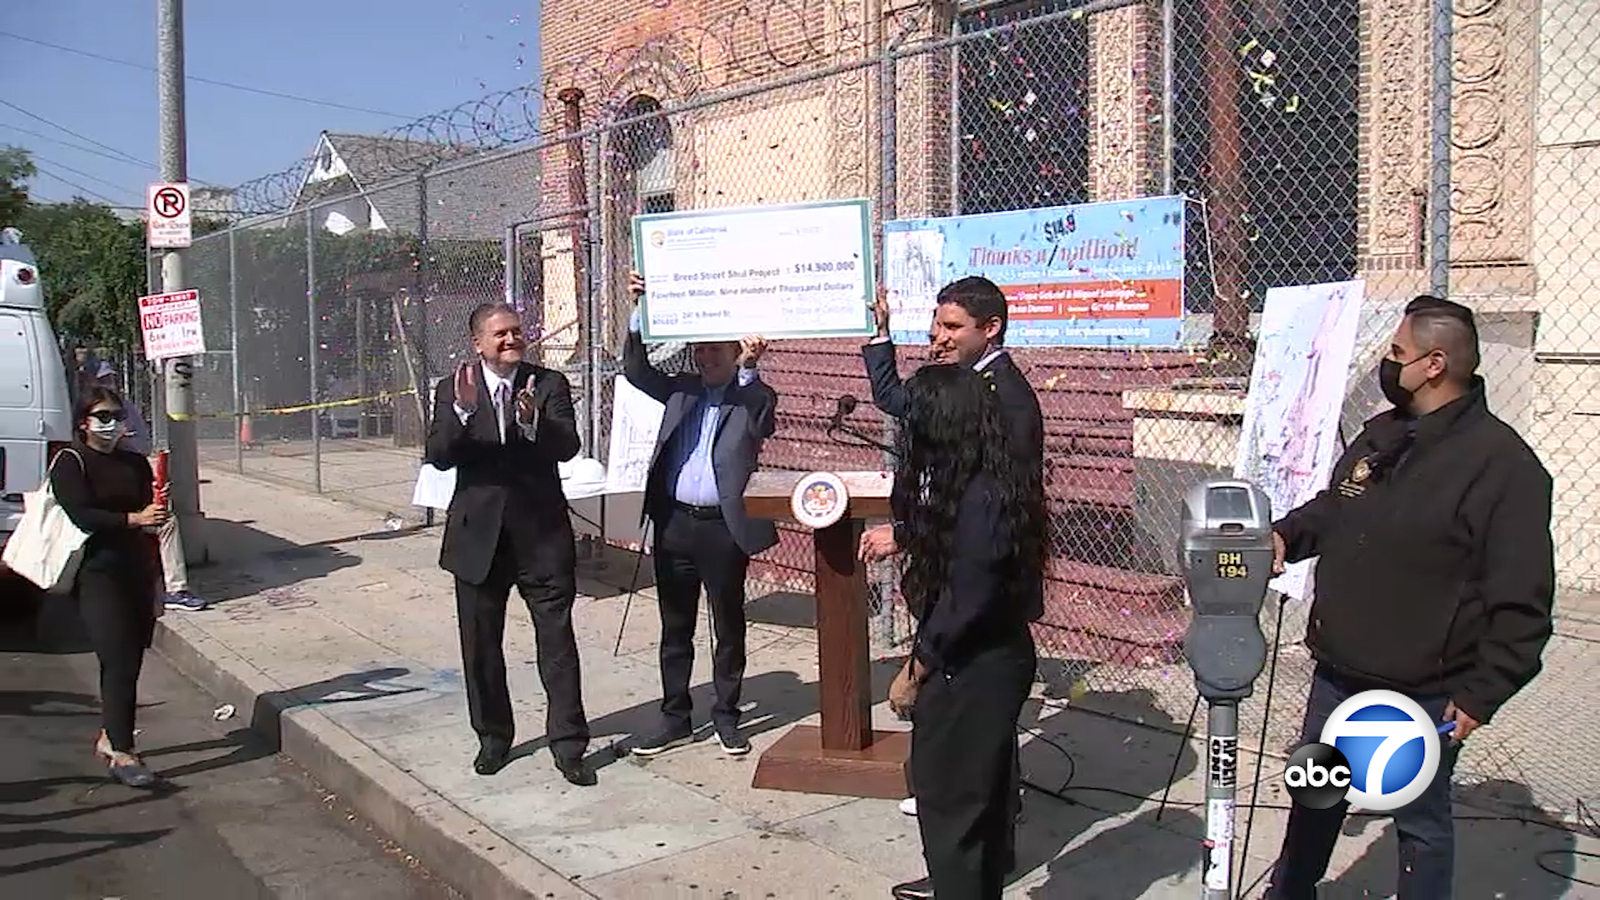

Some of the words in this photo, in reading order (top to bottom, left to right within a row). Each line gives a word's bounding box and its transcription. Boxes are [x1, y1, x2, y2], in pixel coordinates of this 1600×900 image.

[695, 226, 727, 236] California
[969, 246, 1032, 267] Thanks
[673, 272, 698, 282] Breed
[700, 270, 725, 281] Street
[728, 268, 747, 279] Shul
[749, 267, 780, 280] Project
[651, 289, 686, 300] Fourteen
[719, 287, 738, 297] Nine
[740, 284, 777, 296] Hundred
[779, 283, 821, 293] Thousand
[823, 281, 854, 292] Dollars
[146, 313, 163, 329] NO
[164, 310, 199, 326] PARKING
[1218, 552, 1241, 565] BH
[1217, 565, 1247, 578] 194
